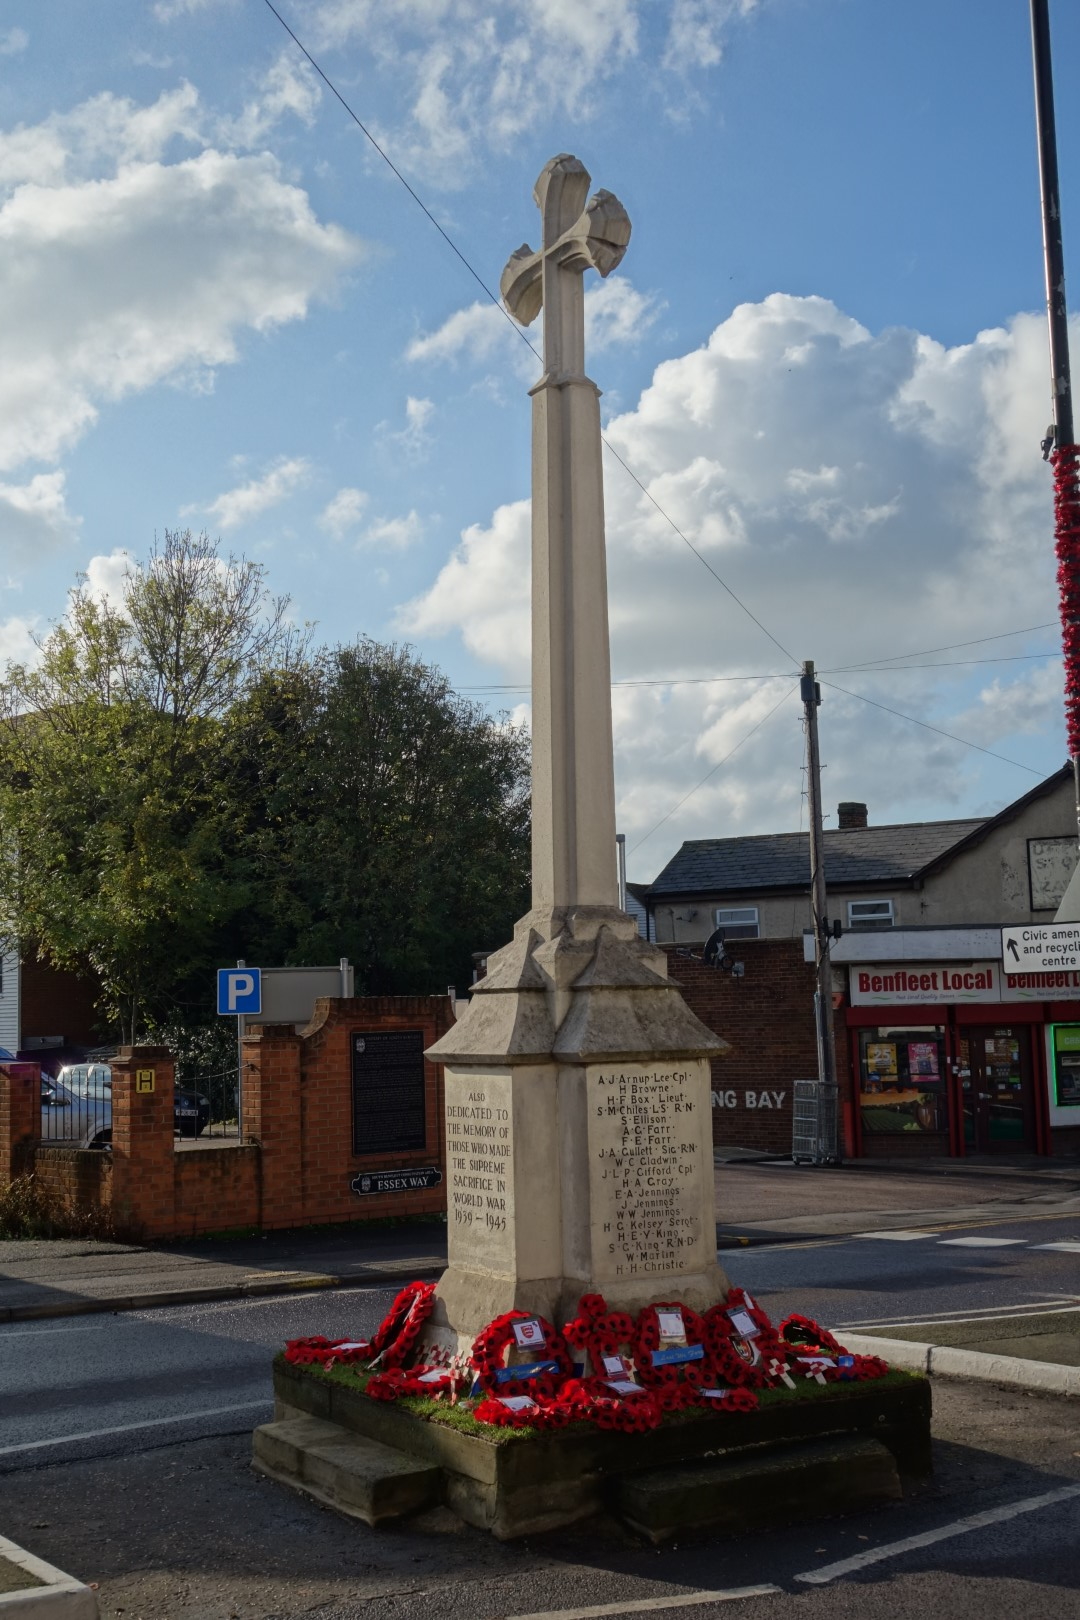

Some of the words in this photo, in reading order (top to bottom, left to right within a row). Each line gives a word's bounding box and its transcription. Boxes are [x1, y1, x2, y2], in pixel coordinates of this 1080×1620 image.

[1022, 930, 1048, 941] Civic
[1023, 944, 1042, 954] and
[1042, 956, 1076, 966] centre
[859, 972, 939, 992] Benfleet
[942, 969, 992, 990] Local
[228, 974, 254, 1010] P
[140, 1072, 152, 1090] H
[468, 1092, 486, 1102] ALSO
[745, 1091, 786, 1108] BAY
[447, 1106, 492, 1120] DEDICATED
[496, 1108, 508, 1120] TO
[447, 1123, 461, 1135] THE
[464, 1124, 497, 1138] MEMORY
[499, 1126, 510, 1139] OF
[447, 1140, 470, 1152] THOSE
[471, 1142, 488, 1154] WHO
[489, 1144, 511, 1157] MADE
[452, 1157, 466, 1170] THE
[469, 1159, 506, 1174] SUPREME
[378, 1178, 407, 1190] ESSEX
[410, 1176, 429, 1186] WAY
[453, 1175, 493, 1191] SACRIFICE
[497, 1180, 506, 1192] IN
[453, 1192, 482, 1207] WORLD
[486, 1196, 506, 1211] WAR
[455, 1208, 472, 1226] 1939
[486, 1212, 506, 1232] 1945
